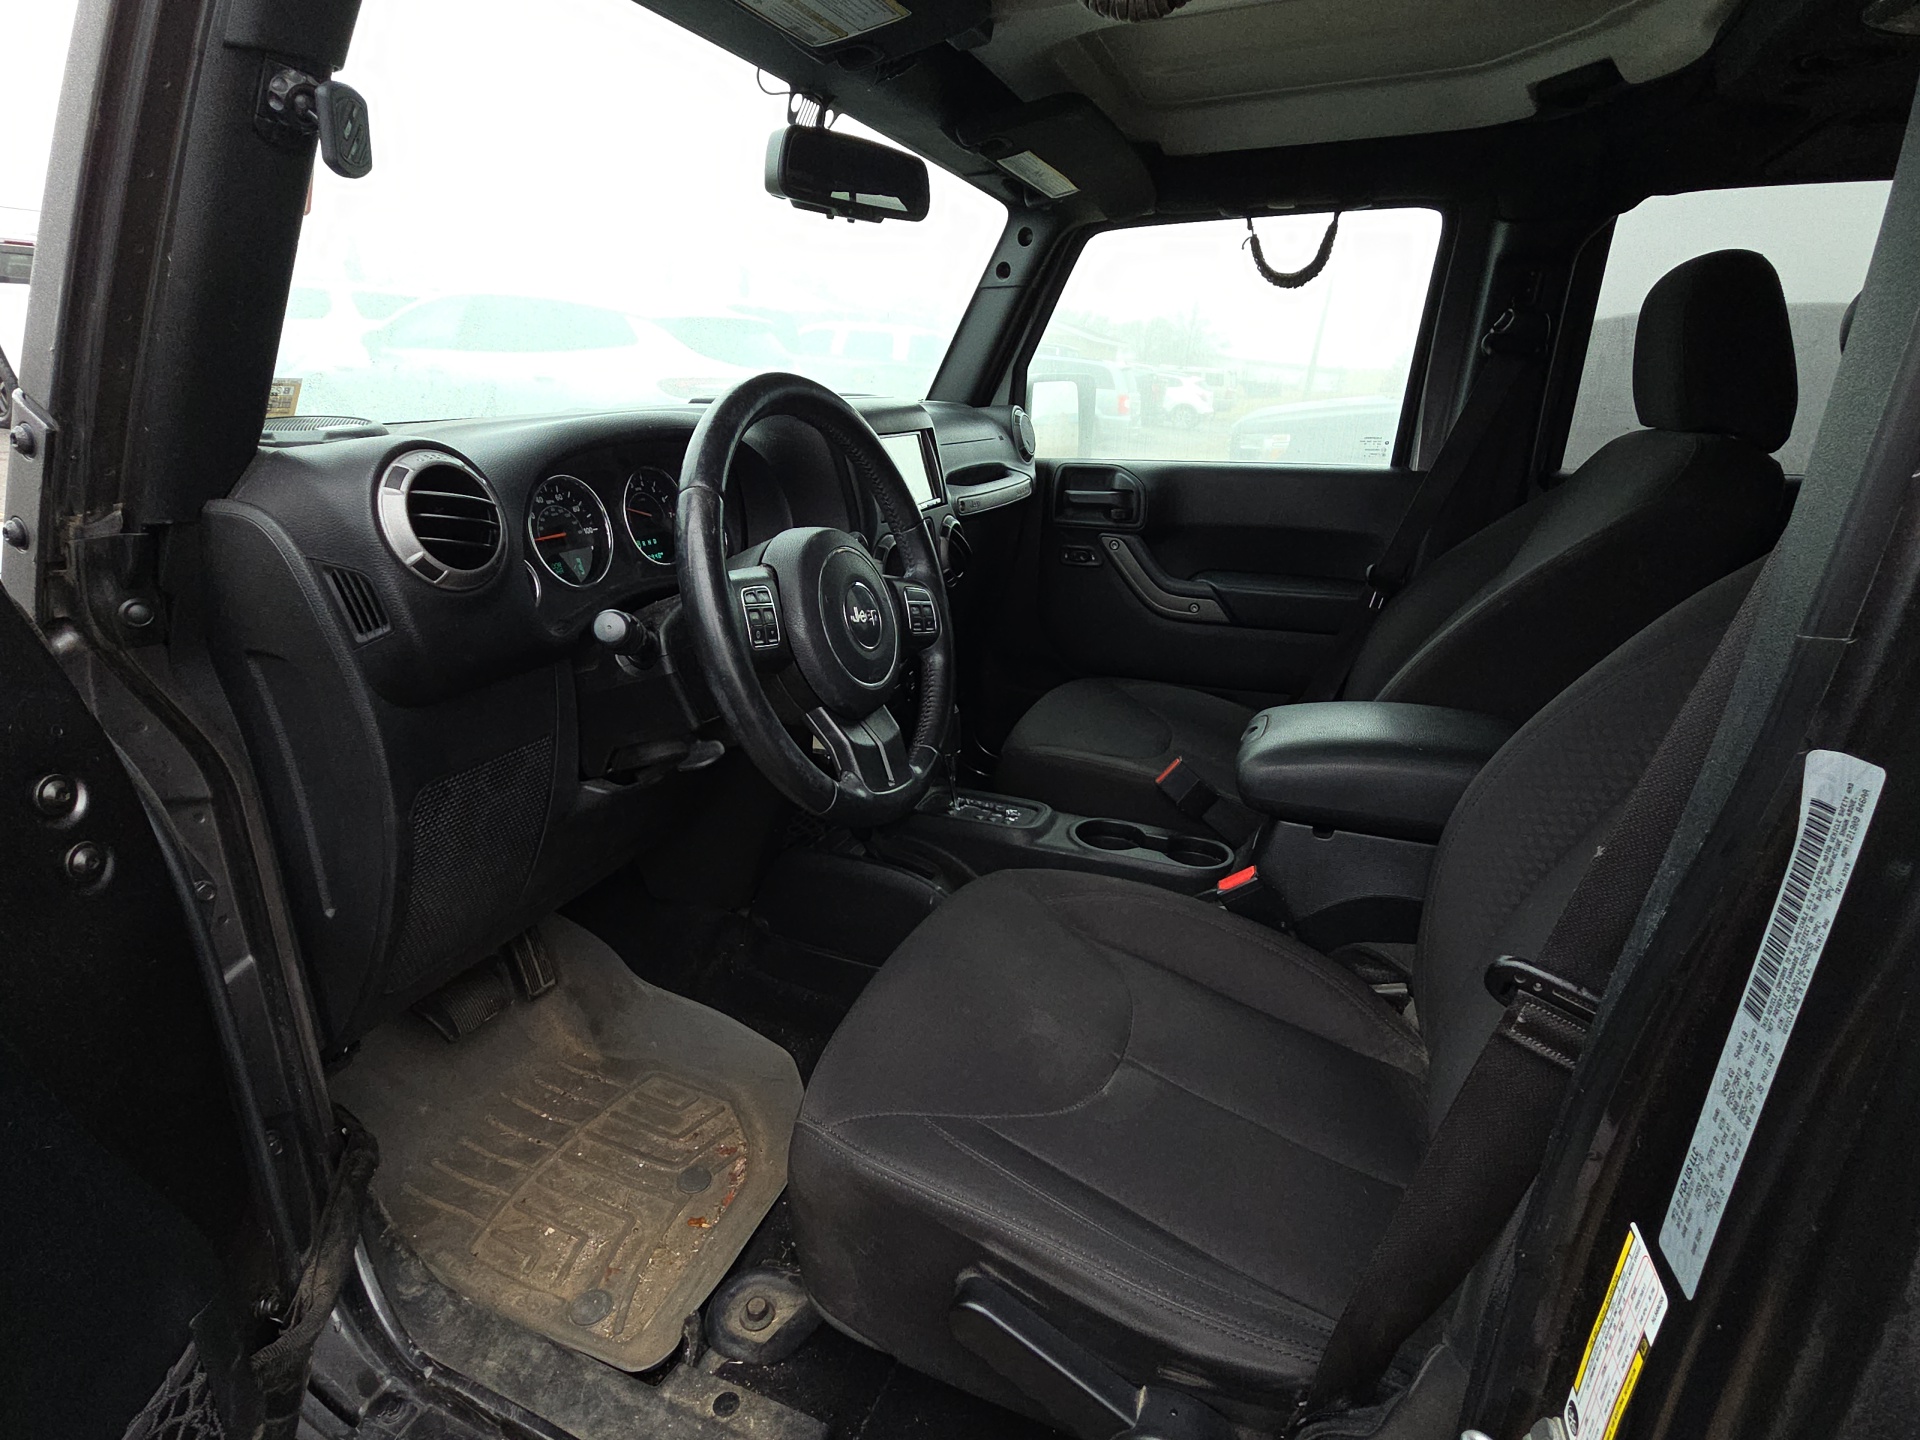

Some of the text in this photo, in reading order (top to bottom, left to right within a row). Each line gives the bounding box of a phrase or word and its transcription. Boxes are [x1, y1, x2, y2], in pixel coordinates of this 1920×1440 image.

[850, 605, 879, 626] Jeep
[1679, 1179, 1688, 1197] FCA
[1685, 1165, 1693, 1179] US
[1690, 1147, 1699, 1165] LLC
